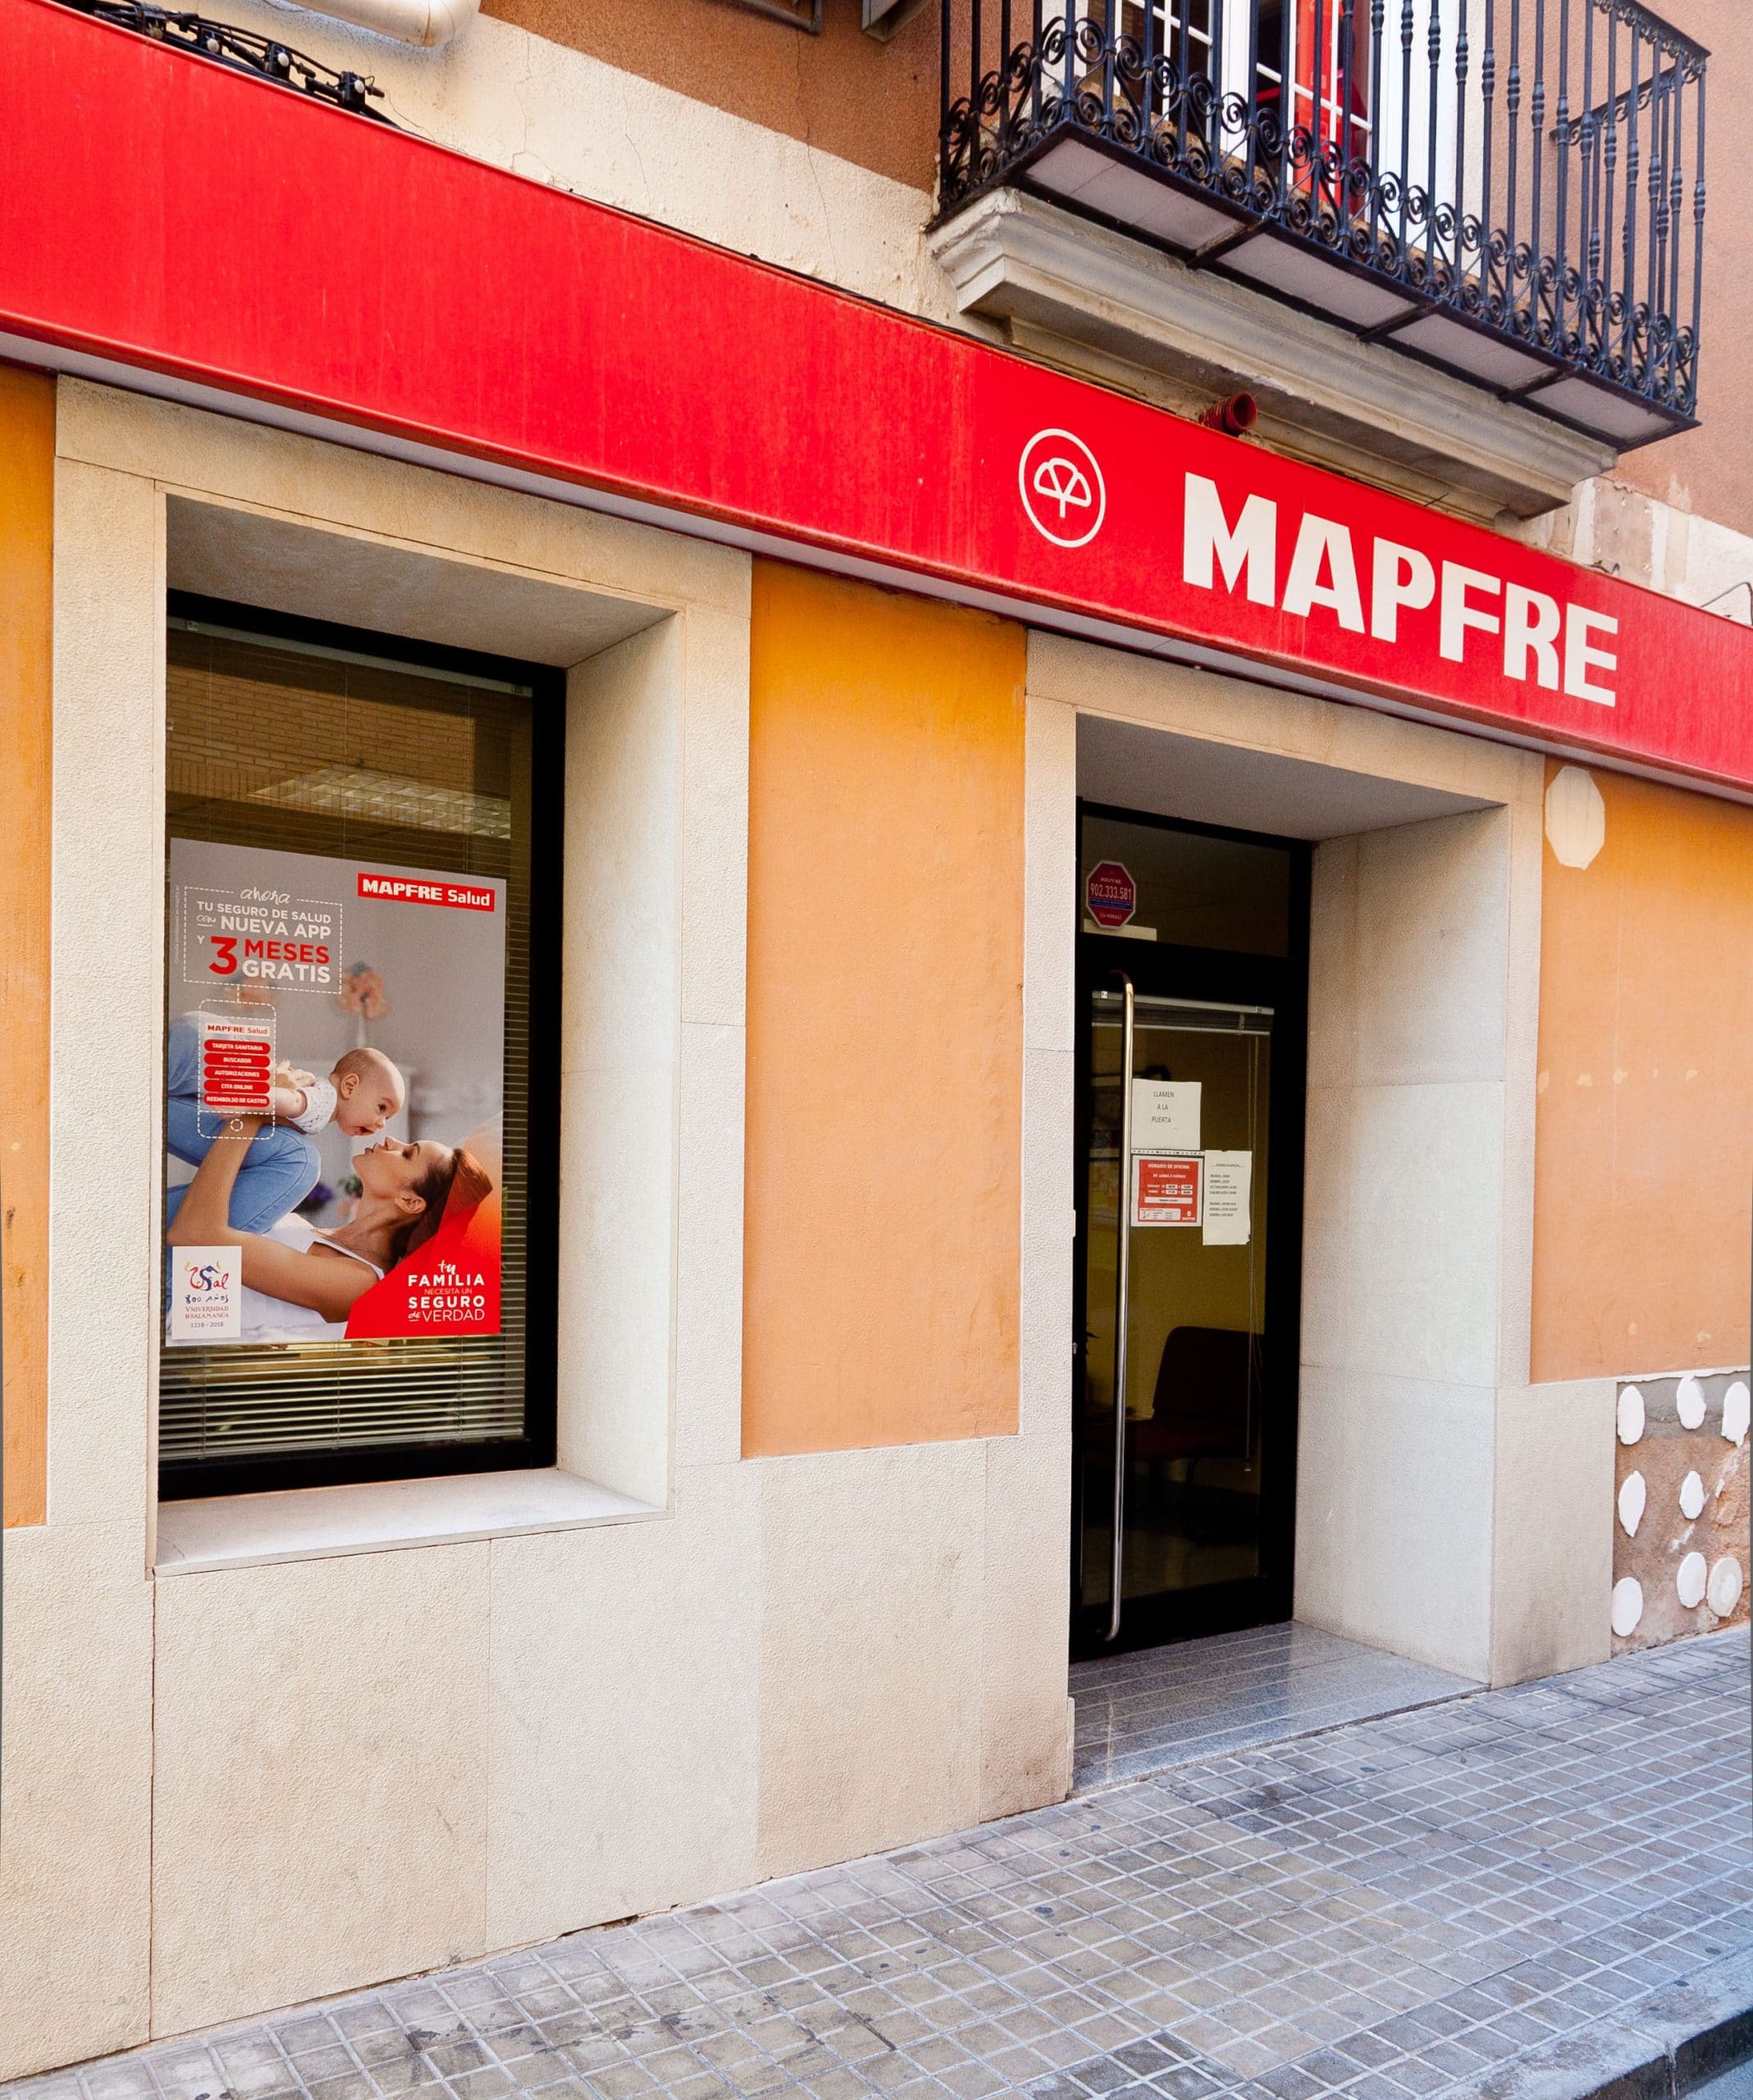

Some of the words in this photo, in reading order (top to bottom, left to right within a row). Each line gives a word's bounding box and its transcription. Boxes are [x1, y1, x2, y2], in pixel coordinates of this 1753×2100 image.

[1183, 472, 1618, 708] MAPFRE
[240, 886, 291, 906] ahora
[362, 879, 443, 901] MAPFRE
[447, 889, 491, 906] Salud
[196, 901, 213, 911] TU
[217, 903, 268, 917] SEGURO
[272, 909, 288, 920] DE
[291, 911, 331, 924] SALUD
[220, 915, 289, 936] NUEVA
[293, 923, 332, 940] APP
[196, 934, 205, 944] Y
[208, 934, 238, 976] 3
[244, 938, 330, 965] MESES
[242, 959, 331, 984] GRATIS
[207, 1025, 245, 1034] MAPFRE
[247, 1026, 268, 1034] Salud
[212, 1043, 234, 1051] TARJETA
[1153, 1090, 1175, 1098] LLAMEN
[437, 1259, 457, 1276] tu
[408, 1273, 486, 1287] FAMILIA
[408, 1294, 486, 1309] SEGURO
[421, 1308, 486, 1322] VERDAD
